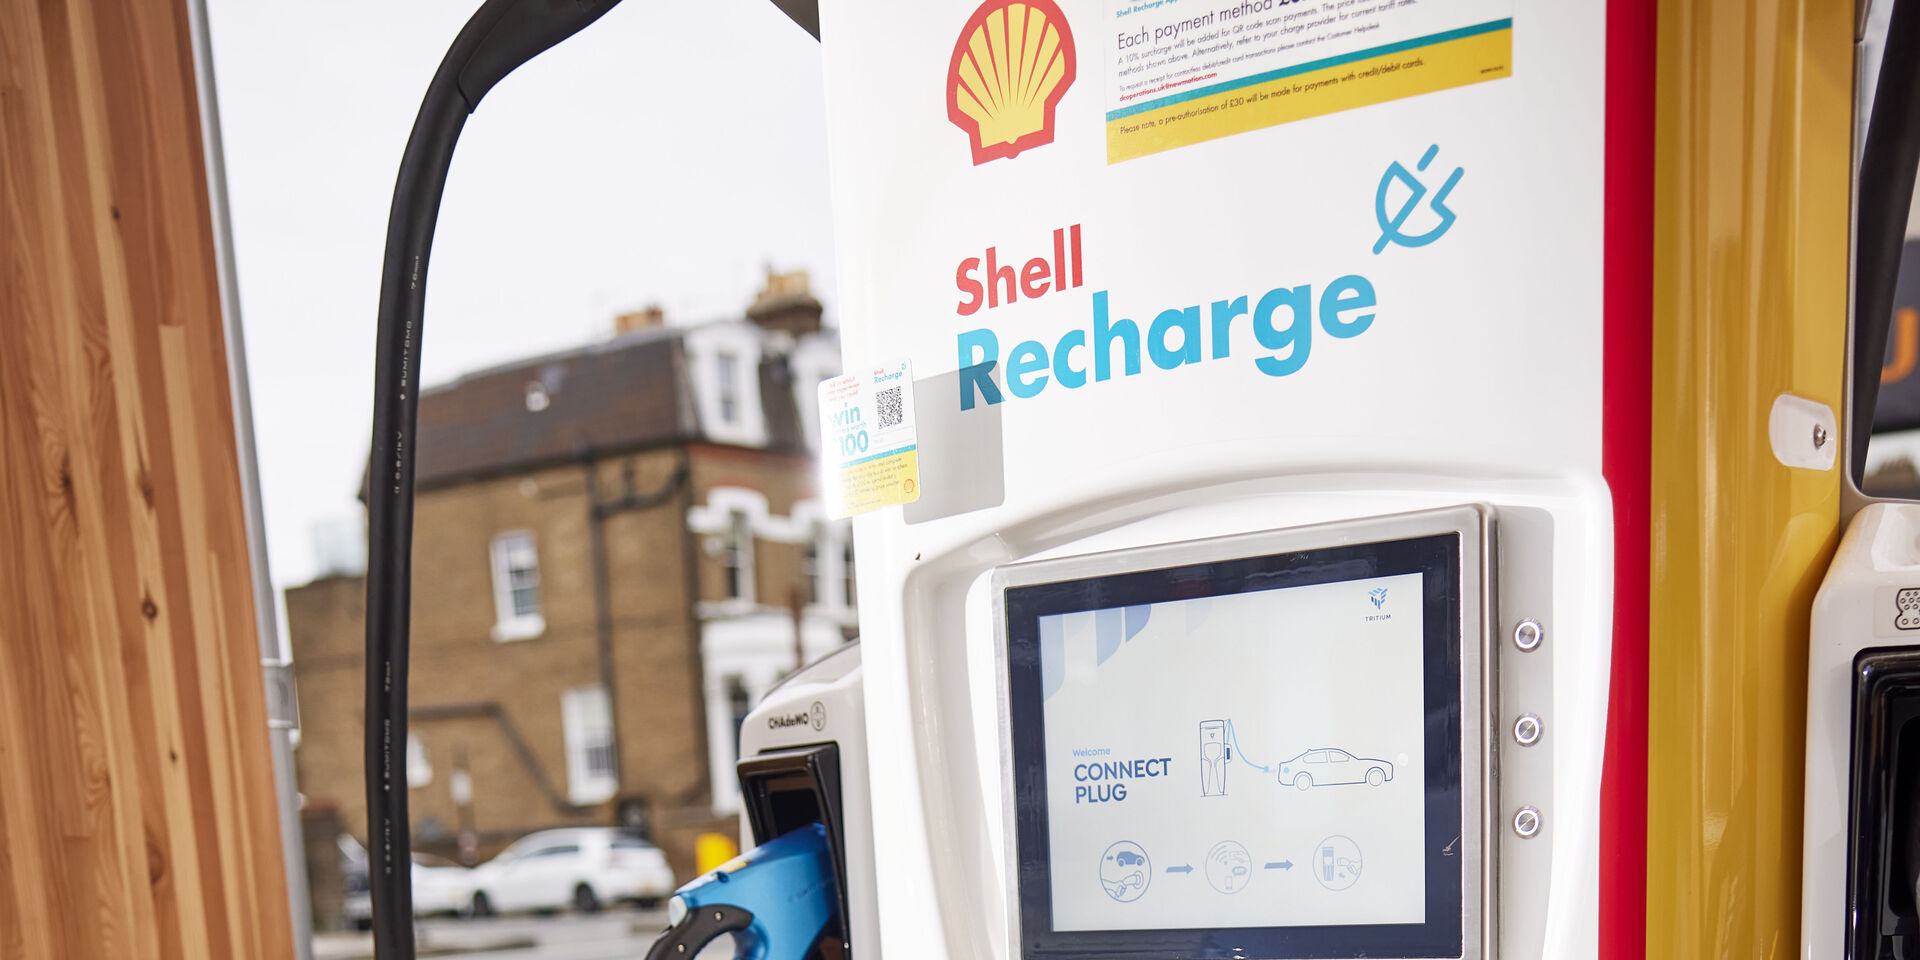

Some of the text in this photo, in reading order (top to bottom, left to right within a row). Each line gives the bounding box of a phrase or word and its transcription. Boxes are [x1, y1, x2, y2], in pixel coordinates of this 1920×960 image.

[1116, 6, 1131, 18] Shell
[1133, 1, 1163, 13] Recharge
[1118, 0, 1272, 50] Each payment method
[1126, 53, 1139, 62] 10%
[1141, 46, 1171, 59] surcharge
[1174, 39, 1184, 49] will
[1187, 38, 1195, 46] be
[1197, 30, 1219, 43] added
[1221, 28, 1230, 36] for
[1233, 24, 1244, 34] QR
[1246, 20, 1262, 31] code
[1266, 17, 1281, 26] scan
[1322, 3, 1334, 11] The
[1120, 125, 1140, 134] Please
[1165, 105, 1219, 125] pre-authorisation
[1221, 100, 1228, 110] of
[1230, 97, 1244, 108] £30
[1246, 93, 1257, 103] will
[1260, 92, 1269, 101] be
[1271, 87, 1291, 98] made
[1293, 84, 1302, 93] for
[1305, 78, 1338, 92] payments
[1341, 72, 1356, 82] with
[1358, 63, 1400, 79] credit/debit
[956, 223, 1083, 316] Shell
[957, 274, 1377, 412] Recharge
[874, 371, 903, 384] Recharge
[833, 429, 869, 457] 100
[1365, 614, 1391, 622] TRITIUM
[1072, 747, 1111, 758] Welcome
[1074, 758, 1172, 782] CONNECT
[1075, 783, 1127, 804] PLUG
